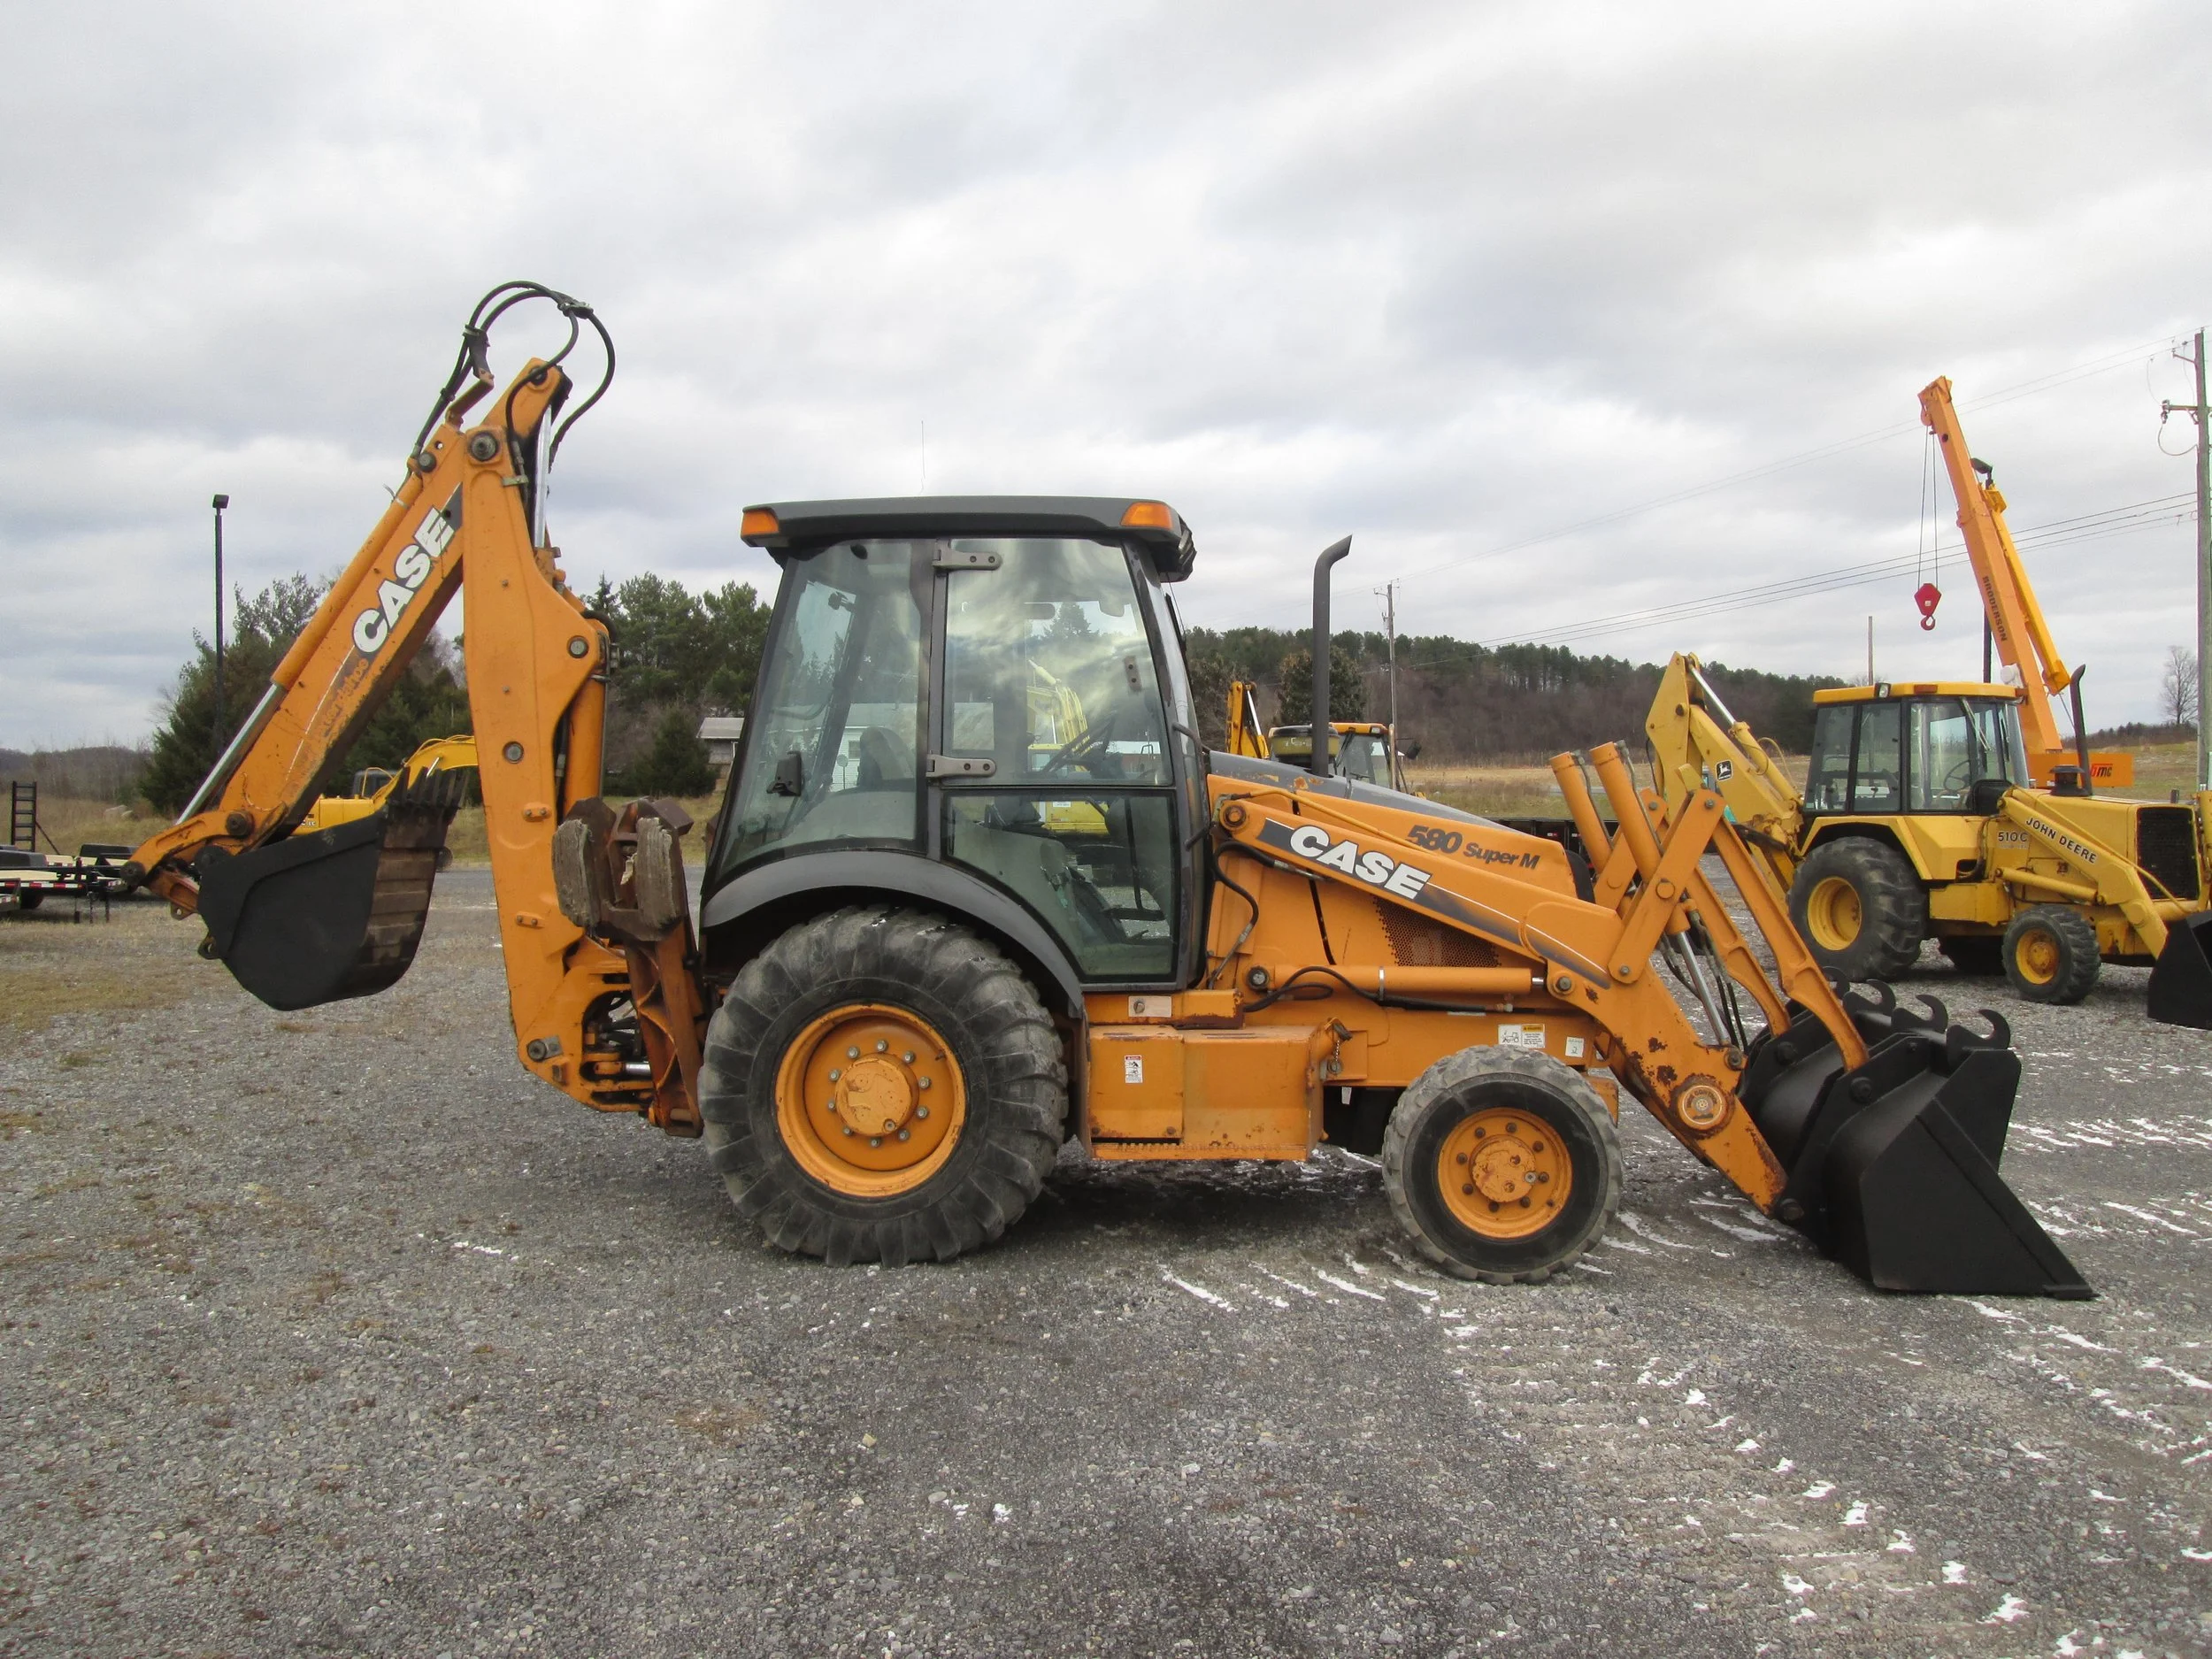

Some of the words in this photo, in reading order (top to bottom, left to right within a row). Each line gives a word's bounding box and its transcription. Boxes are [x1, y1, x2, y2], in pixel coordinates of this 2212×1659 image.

[353, 506, 456, 653] CASE
[1983, 576, 2008, 641] BRODERSON
[1289, 825, 1432, 900] CASE
[1405, 824, 1463, 854] 580
[1463, 841, 1519, 864] Super
[1519, 853, 1540, 870] M
[2026, 818, 2056, 840] JOHN
[2059, 834, 2097, 864] DEERE
